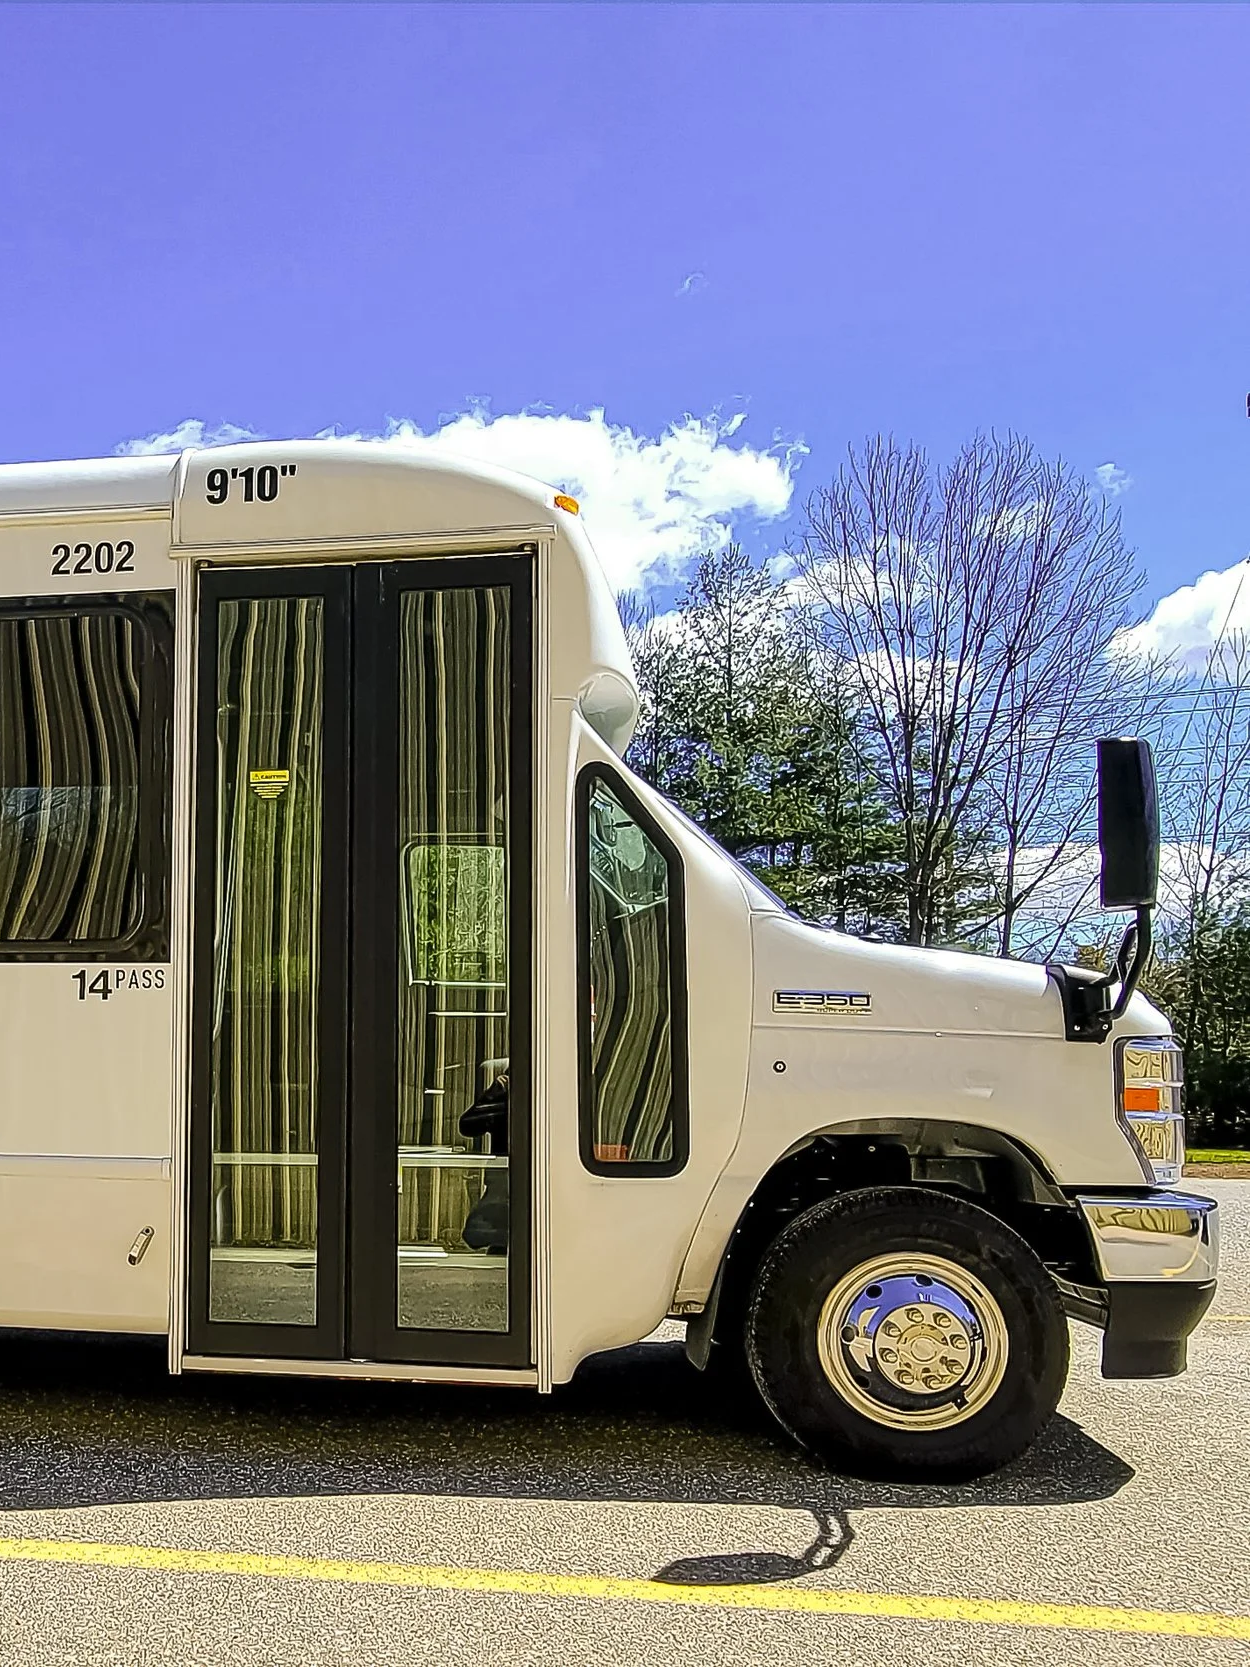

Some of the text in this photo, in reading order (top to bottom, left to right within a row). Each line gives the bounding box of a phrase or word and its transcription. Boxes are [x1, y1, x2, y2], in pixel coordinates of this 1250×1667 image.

[206, 464, 297, 504] 9'10"
[51, 540, 135, 576] 2202
[71, 969, 165, 1000] 14 PASS
